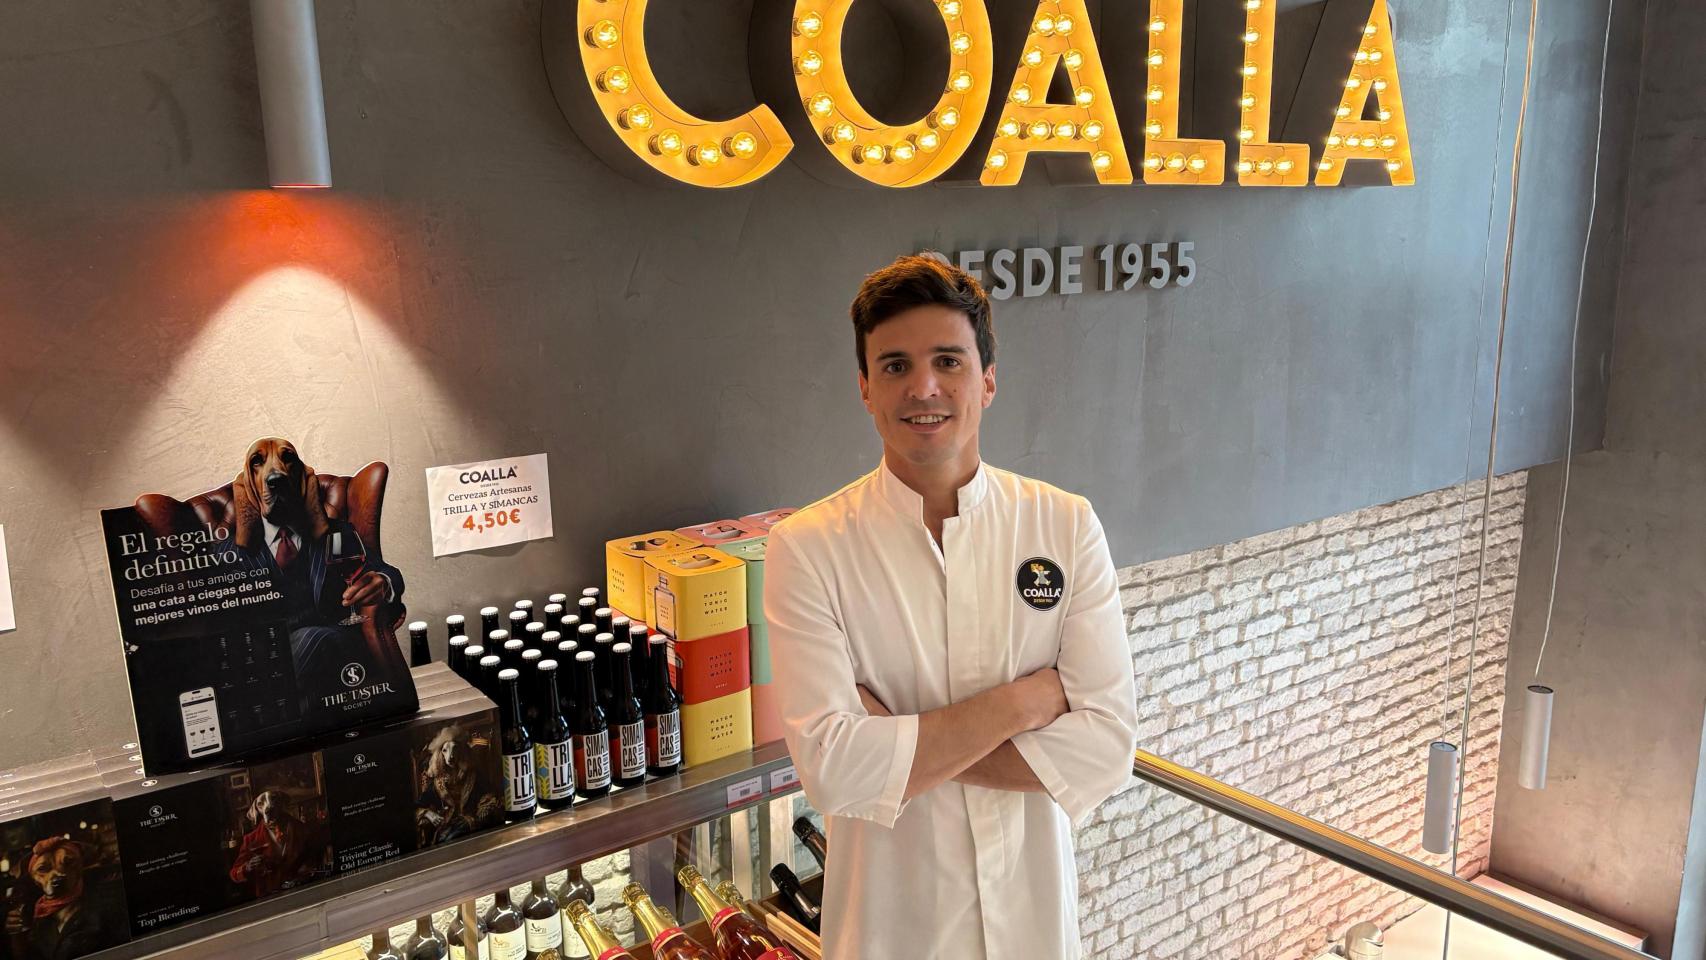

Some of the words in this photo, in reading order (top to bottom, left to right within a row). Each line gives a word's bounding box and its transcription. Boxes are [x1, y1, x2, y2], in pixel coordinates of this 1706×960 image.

[577, 0, 1415, 188] COALLA
[918, 245, 1084, 300] ESDE
[1098, 241, 1197, 292] 1955
[460, 466, 518, 484] COALLA
[448, 490, 488, 501] Cervezas
[490, 484, 532, 497] Artesanas
[443, 504, 477, 515] TRILLA
[489, 495, 538, 509] SIMANCAS
[462, 508, 521, 534] 4,50€
[118, 532, 148, 556] El
[154, 522, 229, 554] regalo
[124, 548, 243, 581] definitivo.
[130, 582, 174, 599] Desafía
[177, 582, 185, 591] a
[187, 579, 205, 590] tus
[207, 571, 247, 584] amigos
[249, 567, 269, 578] con
[1023, 588, 1060, 598] COALLA
[133, 602, 157, 613] una
[159, 595, 186, 608] cata
[188, 594, 196, 602] a
[198, 587, 236, 599] ciegas
[238, 582, 253, 593] de
[255, 579, 272, 590] los
[703, 591, 728, 599] MATCH
[704, 598, 728, 606] TONIC
[135, 609, 184, 626] mejores
[187, 603, 219, 616] vinos
[221, 597, 239, 609] del
[241, 591, 284, 606] mundo.
[704, 606, 728, 615] WATER
[710, 668, 732, 677] WATER
[322, 691, 348, 707] THE
[349, 682, 396, 700] TASTER
[343, 700, 372, 711] SOCIETY
[711, 722, 733, 732] TONIC
[711, 730, 733, 740] WATER
[551, 741, 570, 766] TRI
[623, 746, 638, 767] CAS
[660, 735, 674, 756] CAS
[512, 752, 531, 777] TRI
[553, 763, 573, 788] LLA
[587, 756, 603, 778] CAS
[514, 774, 534, 799] LLA
[340, 861, 356, 871] Old
[357, 854, 384, 867] Europe
[385, 847, 400, 858] Red
[368, 842, 393, 854] Classic
[137, 918, 157, 928] Top
[158, 905, 200, 922] Blendings
